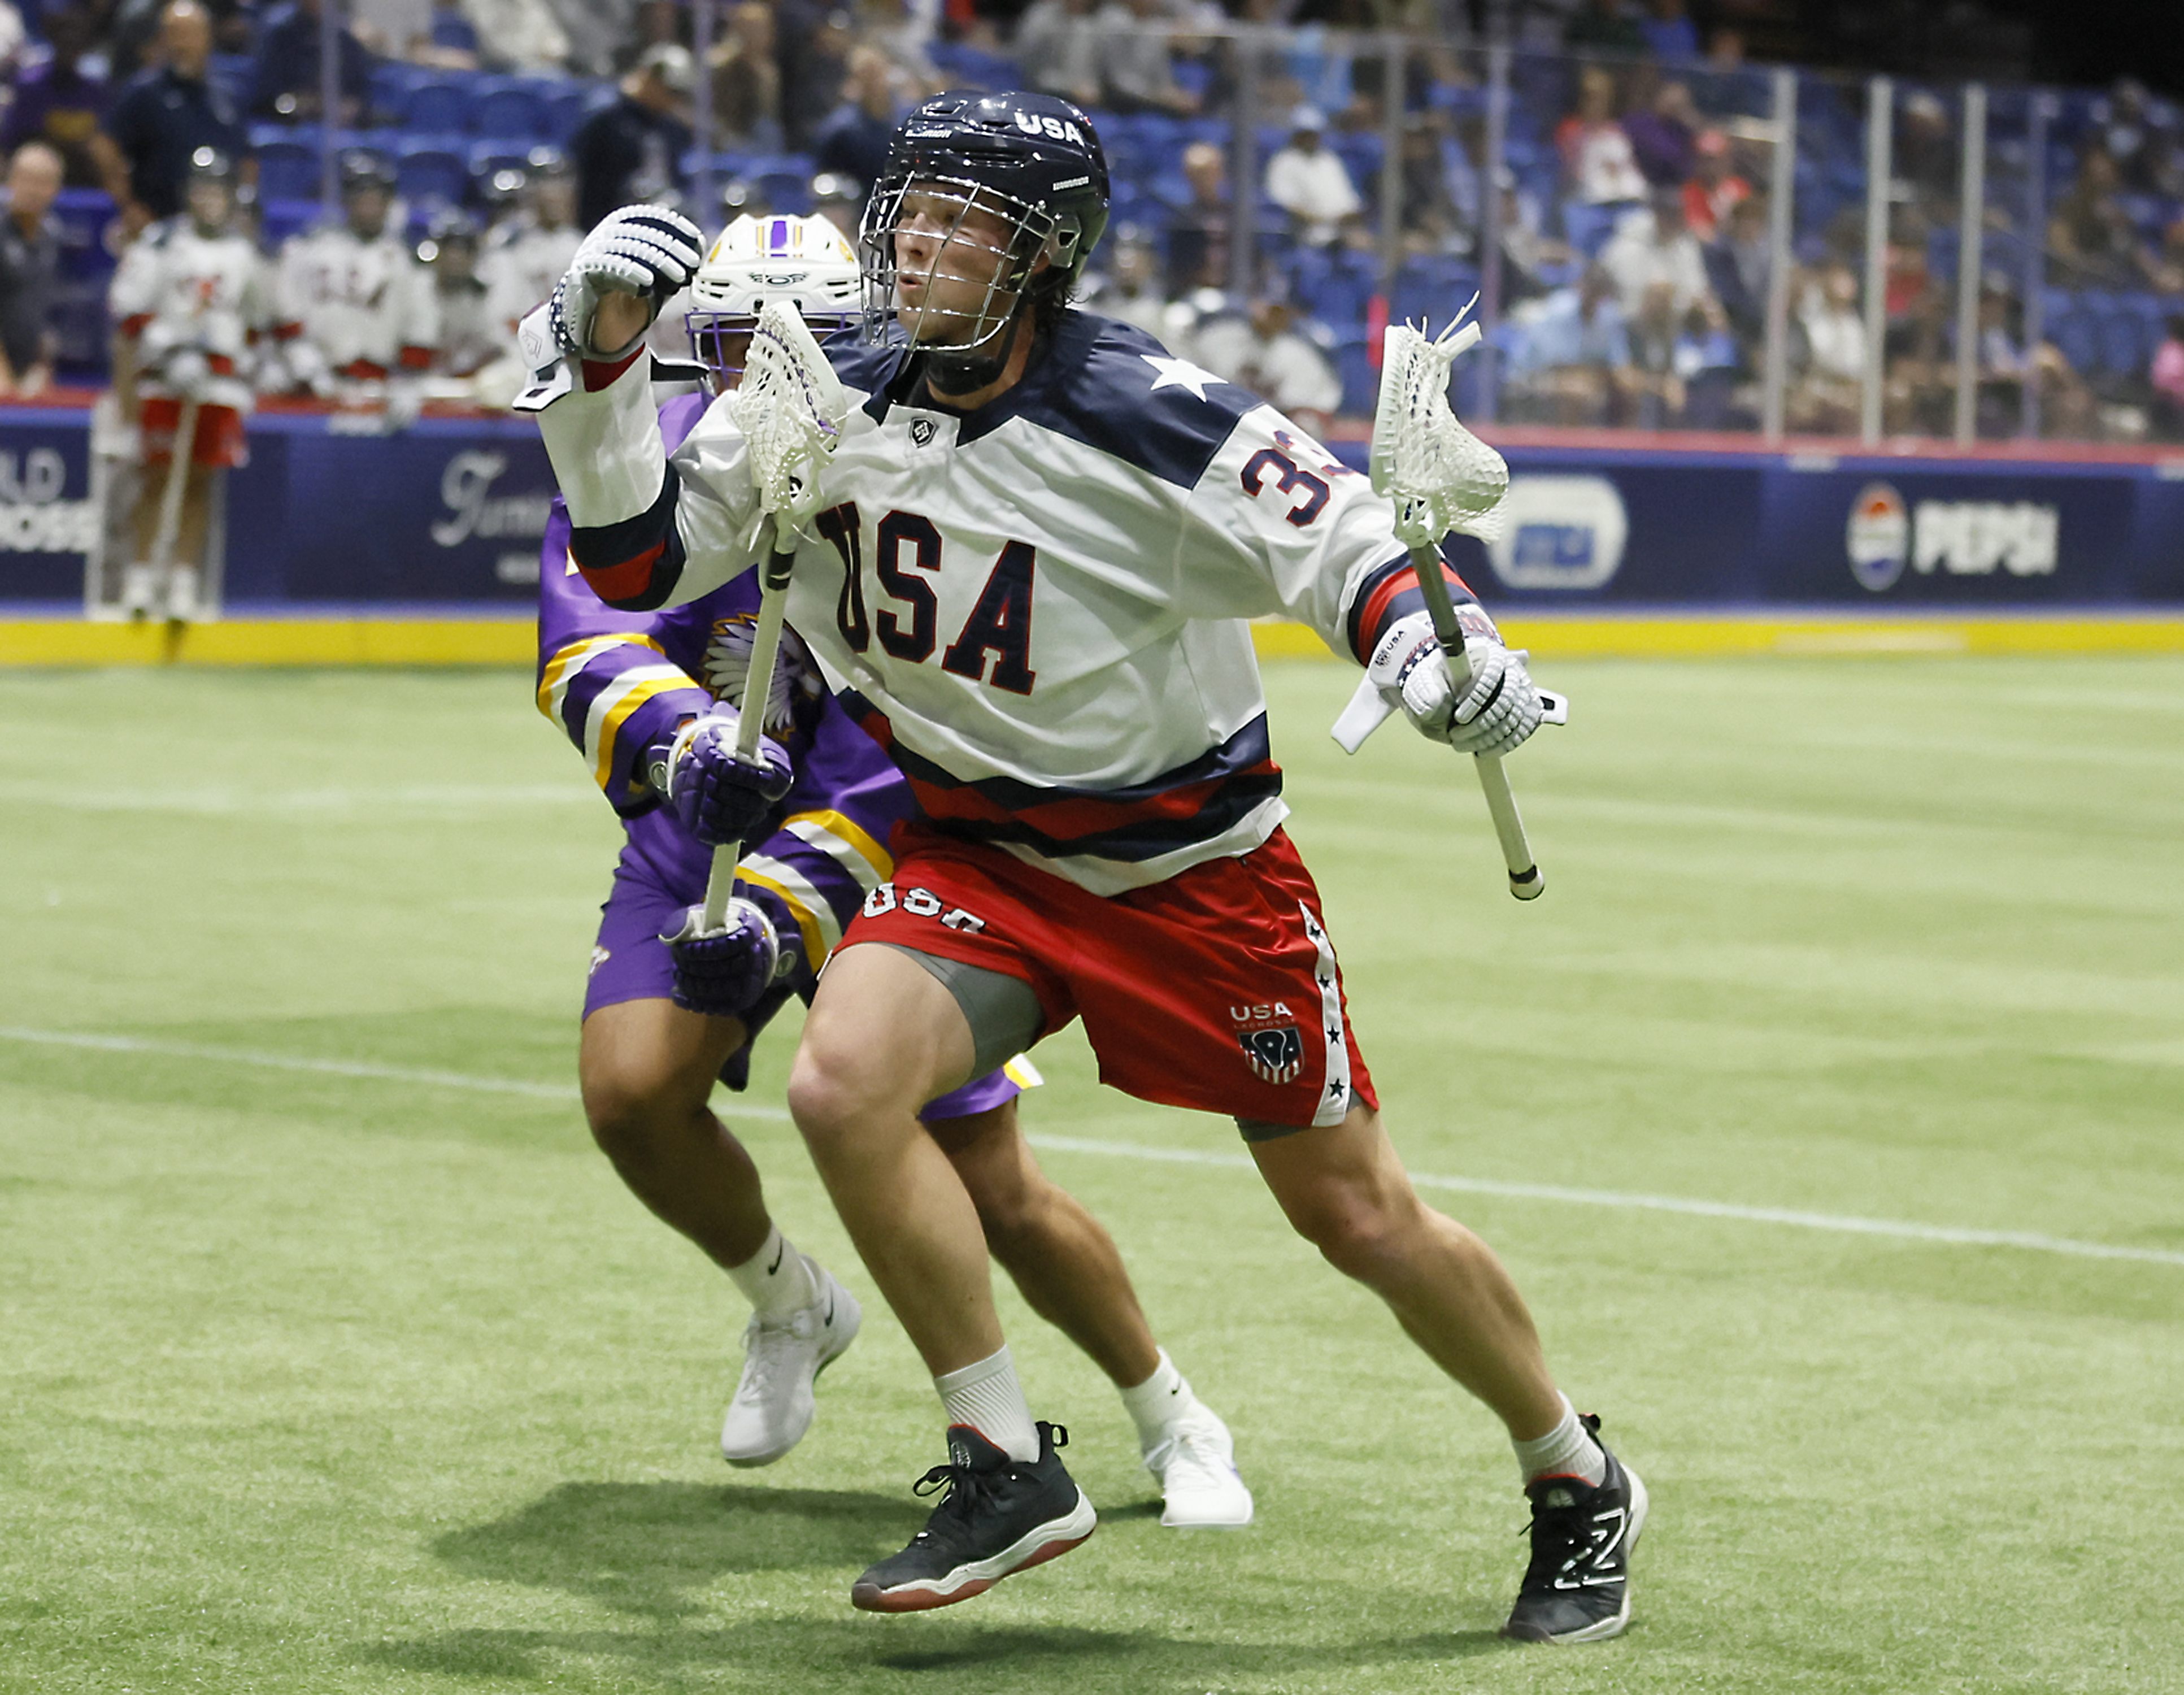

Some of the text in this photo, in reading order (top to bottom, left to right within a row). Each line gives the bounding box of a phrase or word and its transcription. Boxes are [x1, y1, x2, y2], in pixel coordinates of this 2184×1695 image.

[1014, 112, 1085, 147] USA
[0, 449, 66, 503] LD
[1913, 499, 2059, 576] PEPSI
[815, 501, 1037, 696] USA
[1230, 1002, 1293, 1022] USA
